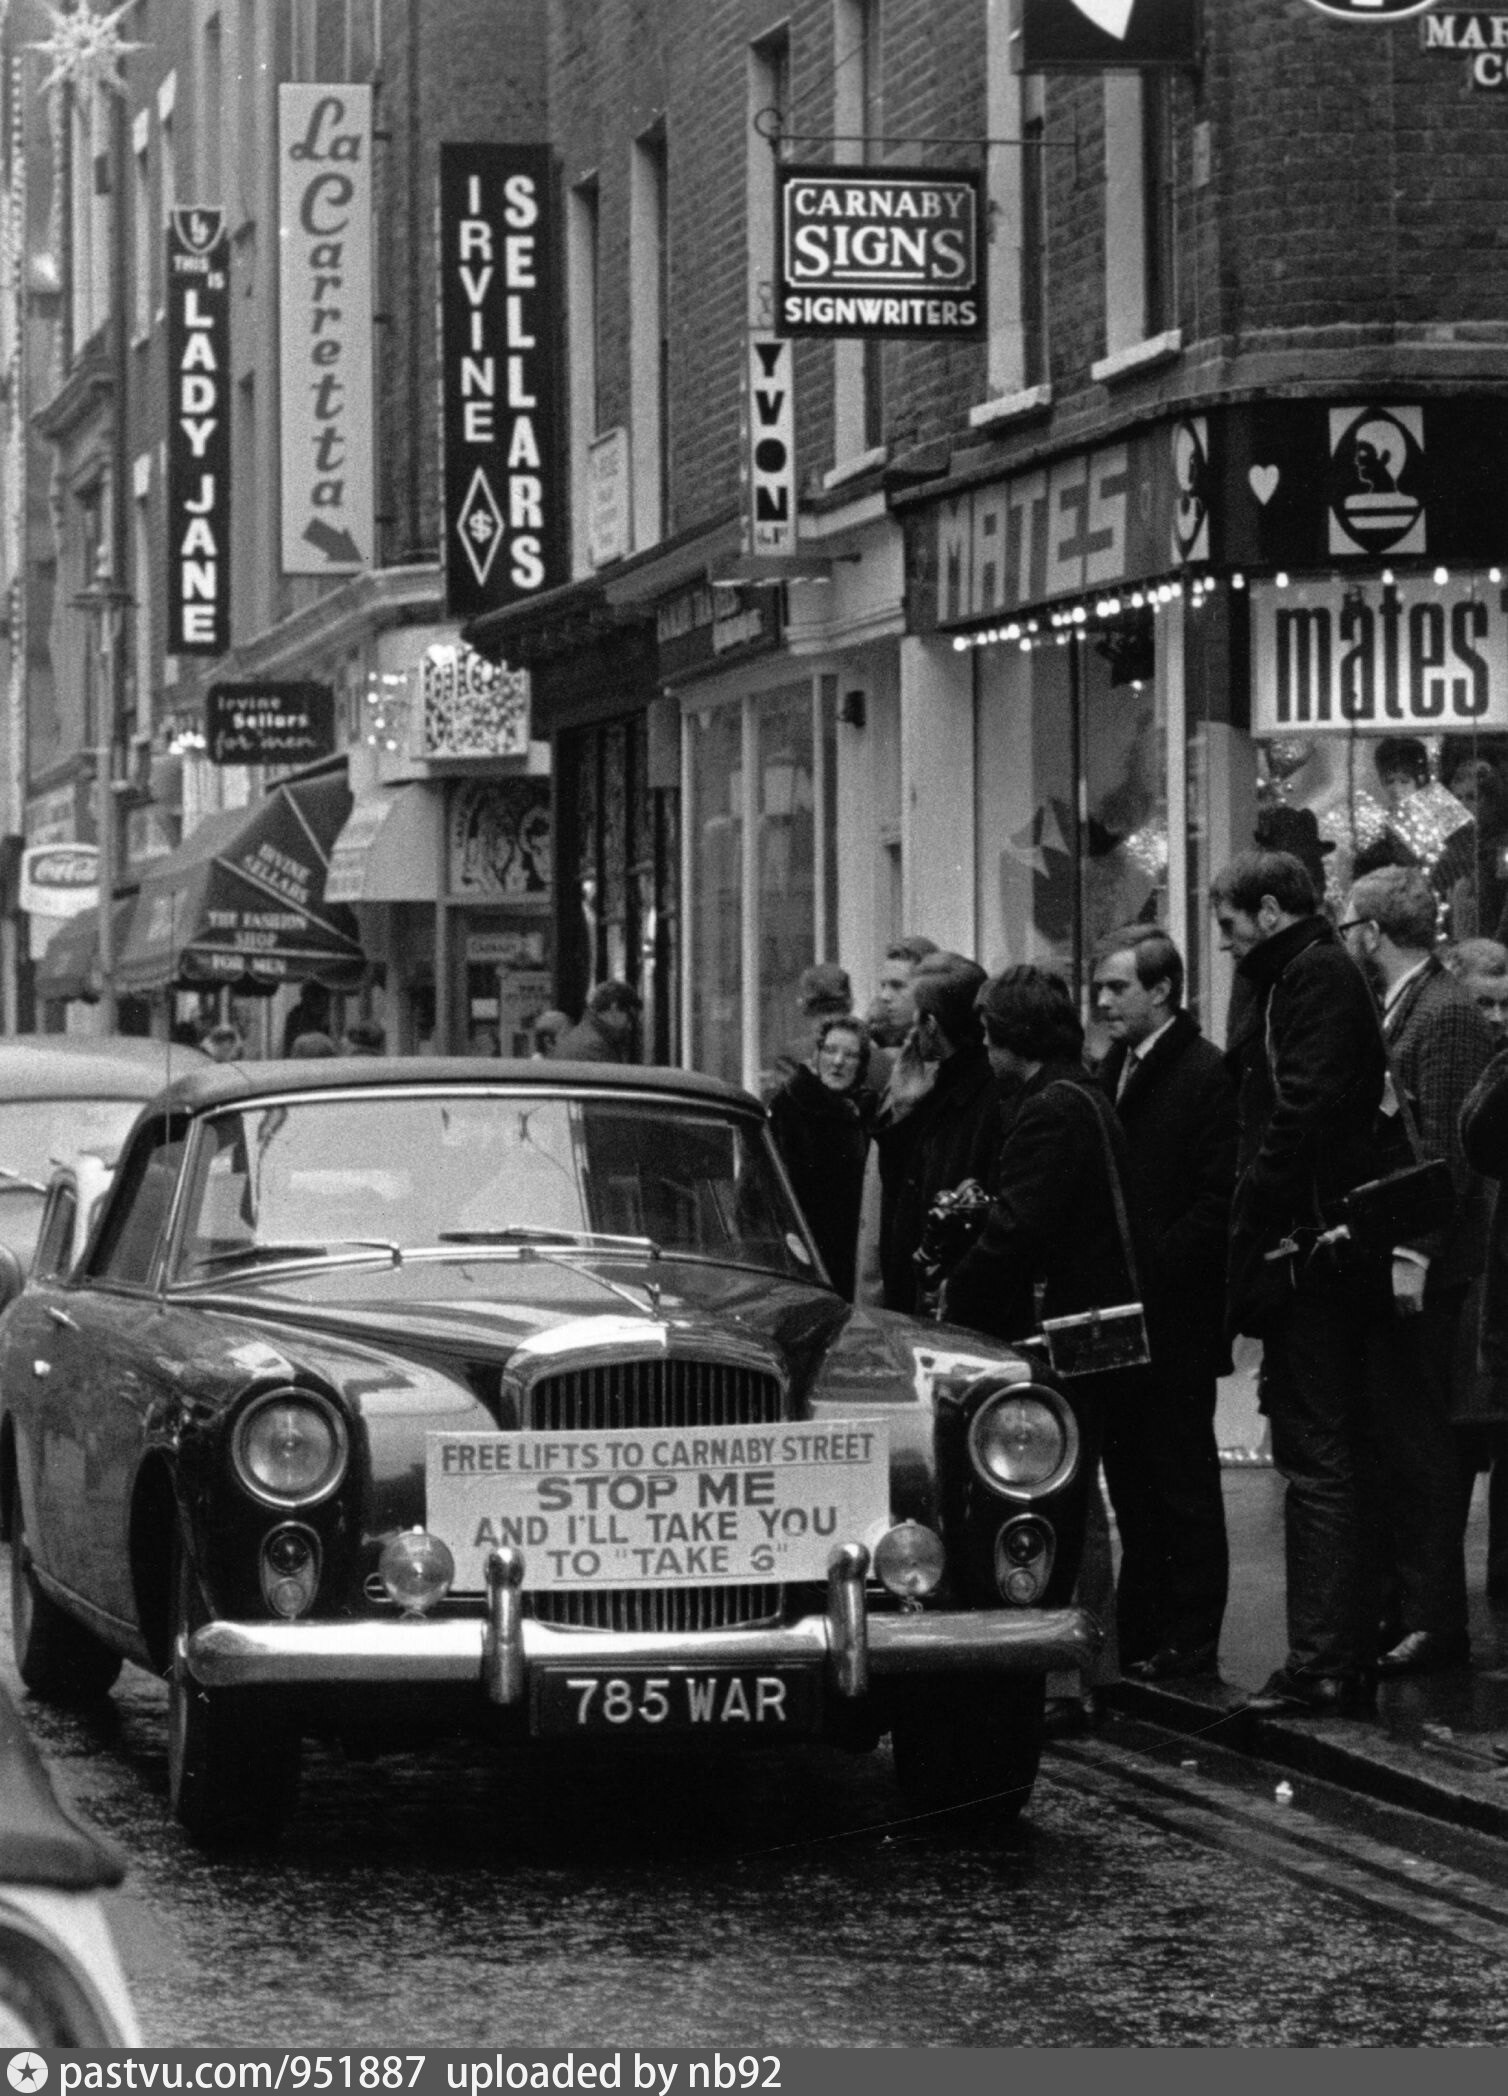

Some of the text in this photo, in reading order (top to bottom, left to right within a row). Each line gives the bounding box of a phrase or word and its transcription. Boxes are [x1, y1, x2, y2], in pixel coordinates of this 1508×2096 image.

[1474, 53, 1508, 85] C
[289, 98, 362, 163] La
[795, 188, 965, 218] CARNABY
[794, 224, 966, 279] SIGNS
[208, 271, 224, 289] IS
[458, 175, 494, 442] IRVINE
[785, 297, 977, 326] SIGNWRITERS
[299, 172, 354, 508] Carretta
[504, 175, 545, 589] SELLARS
[181, 290, 217, 644] LADY JANE
[937, 441, 1127, 622] MATES
[1276, 585, 1489, 722] mates
[218, 696, 280, 710] Irvine
[208, 911, 238, 927] THE
[212, 954, 285, 975] FOR MEN
[442, 1433, 875, 1471] FREE LIFTS TO CARNABY STREET
[537, 1472, 776, 1511] STOP ME
[474, 1507, 838, 1547] AND I'LL TAKE YOU
[547, 1549, 601, 1578] TO
[566, 1677, 787, 1724] 785 WAR
